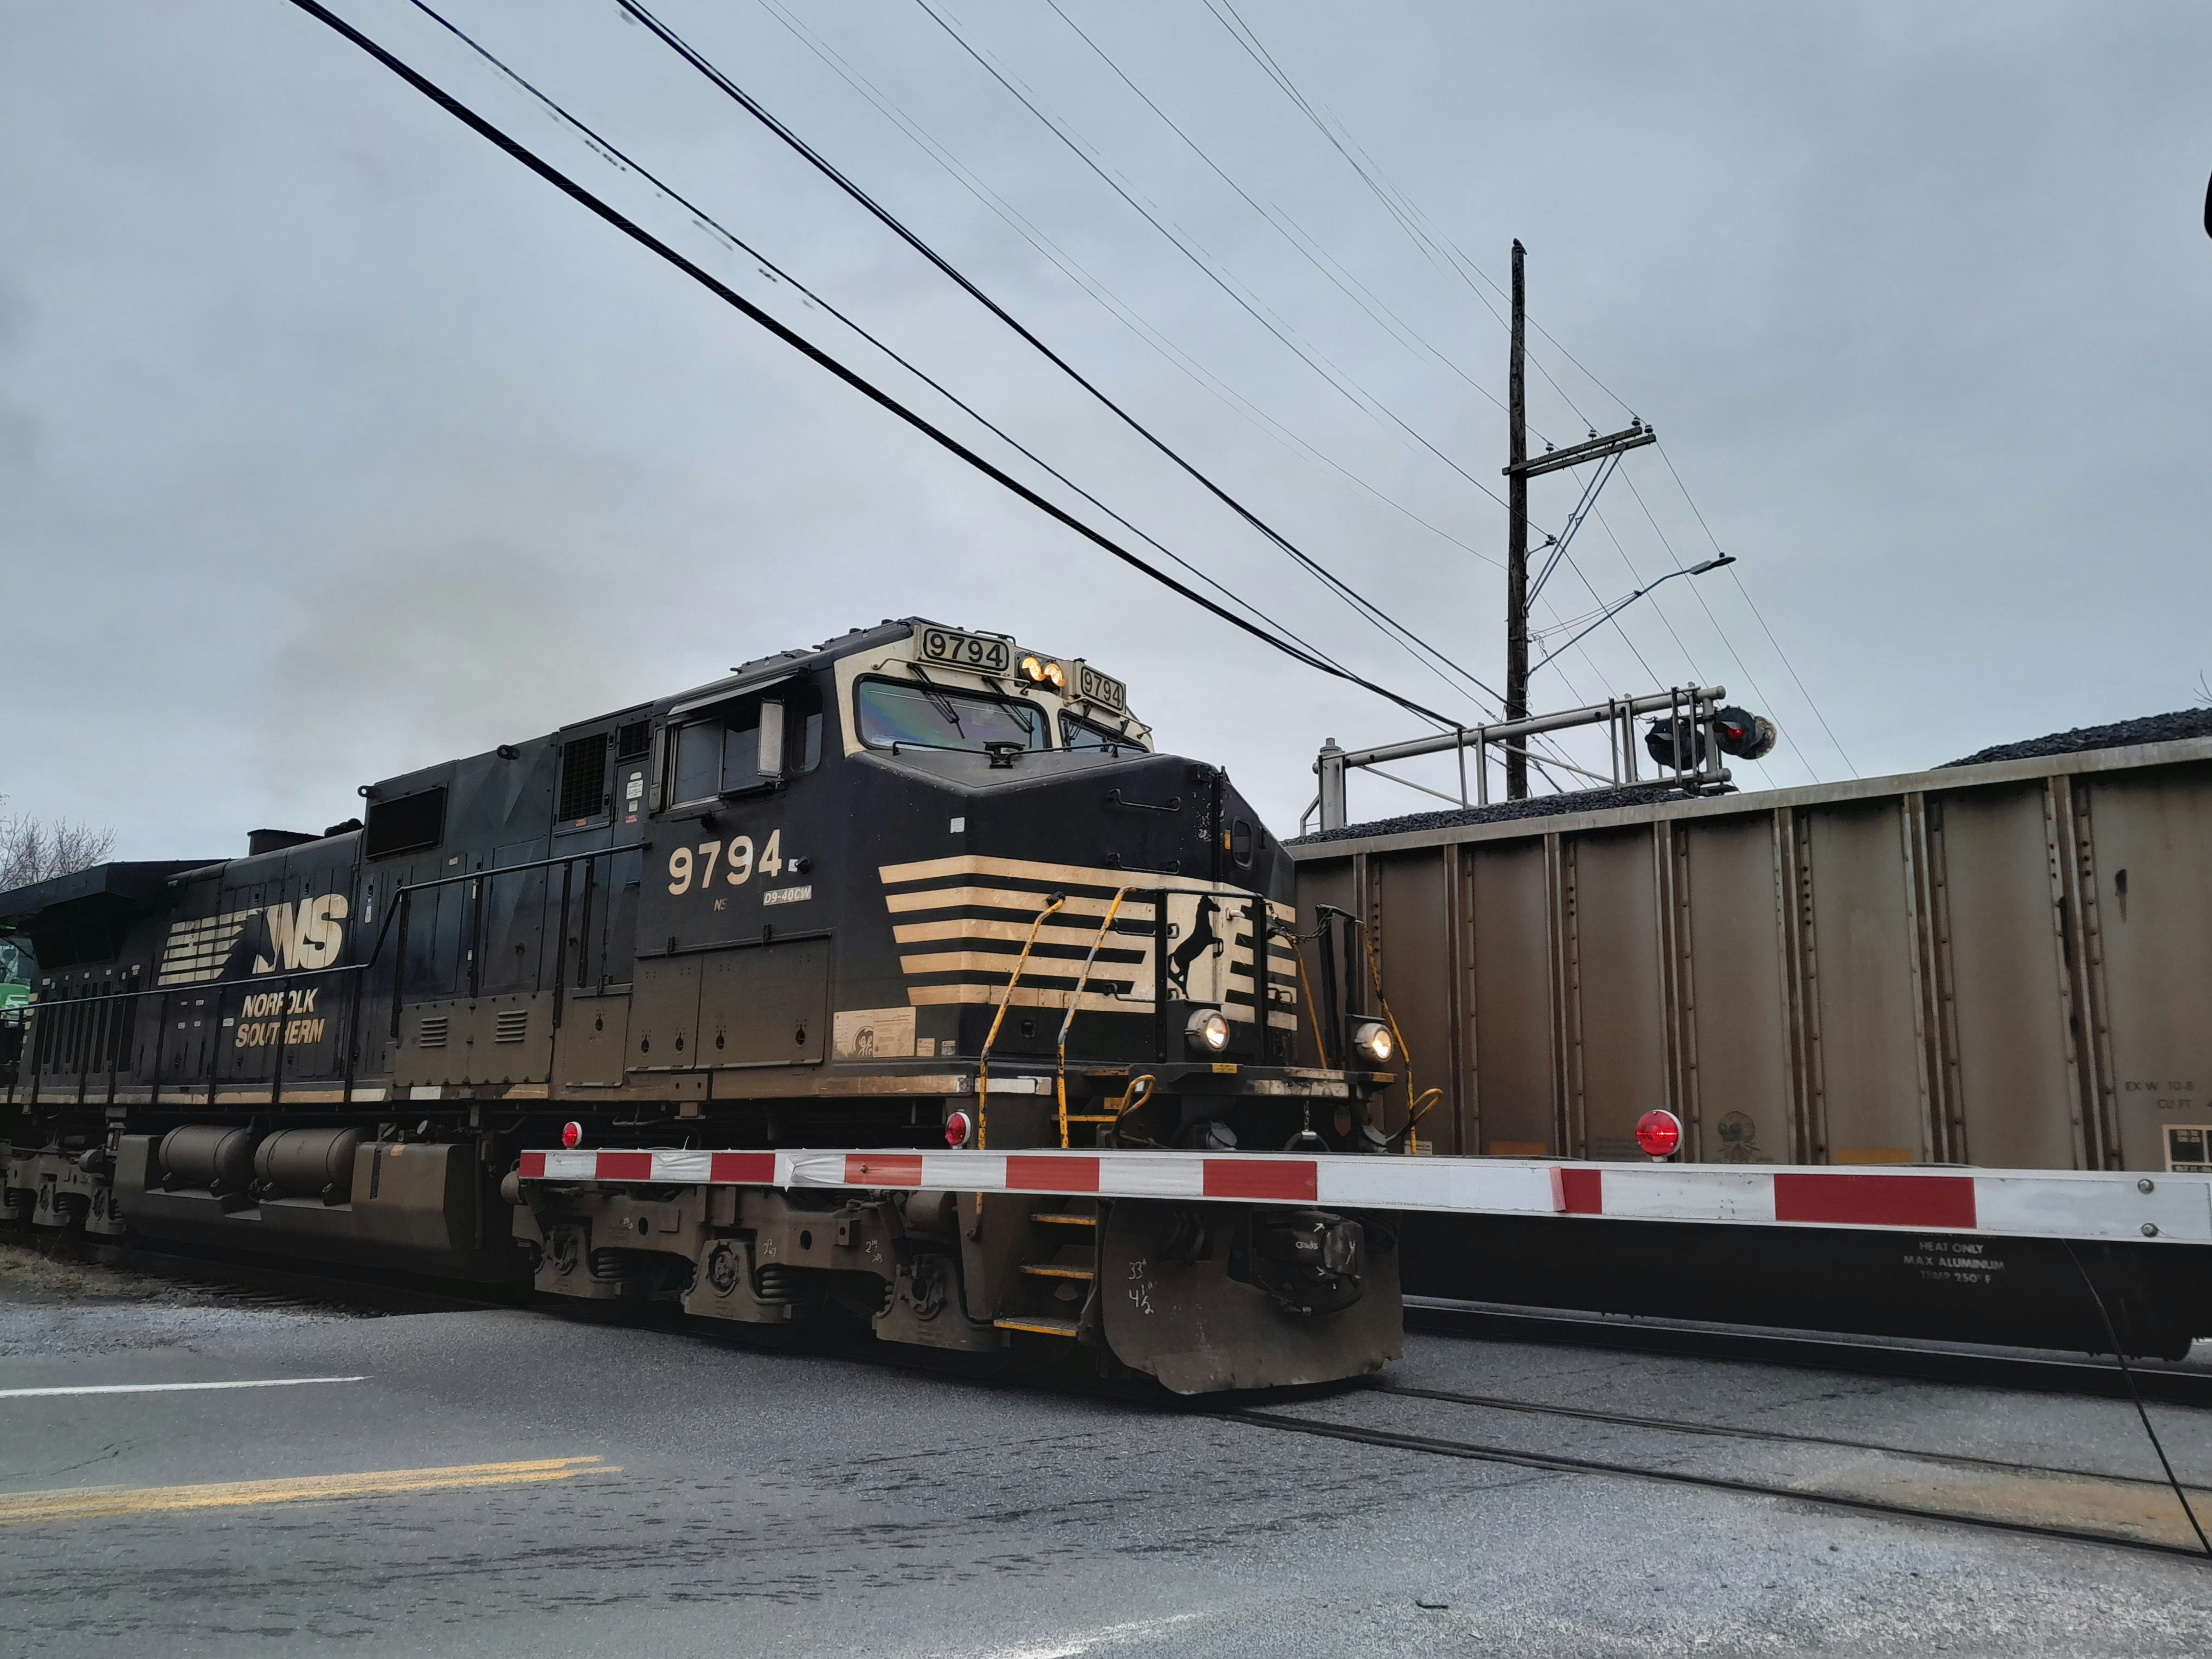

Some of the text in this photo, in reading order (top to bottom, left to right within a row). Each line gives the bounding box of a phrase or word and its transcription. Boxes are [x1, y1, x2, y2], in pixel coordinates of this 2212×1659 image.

[930, 633, 1003, 667] 9794
[1084, 671, 1121, 707] 9794
[668, 828, 782, 895] 9794
[765, 887, 810, 904] D9-40CW
[1903, 1255, 1933, 1266] MAX
[1952, 1242, 1984, 1254] ONLY
